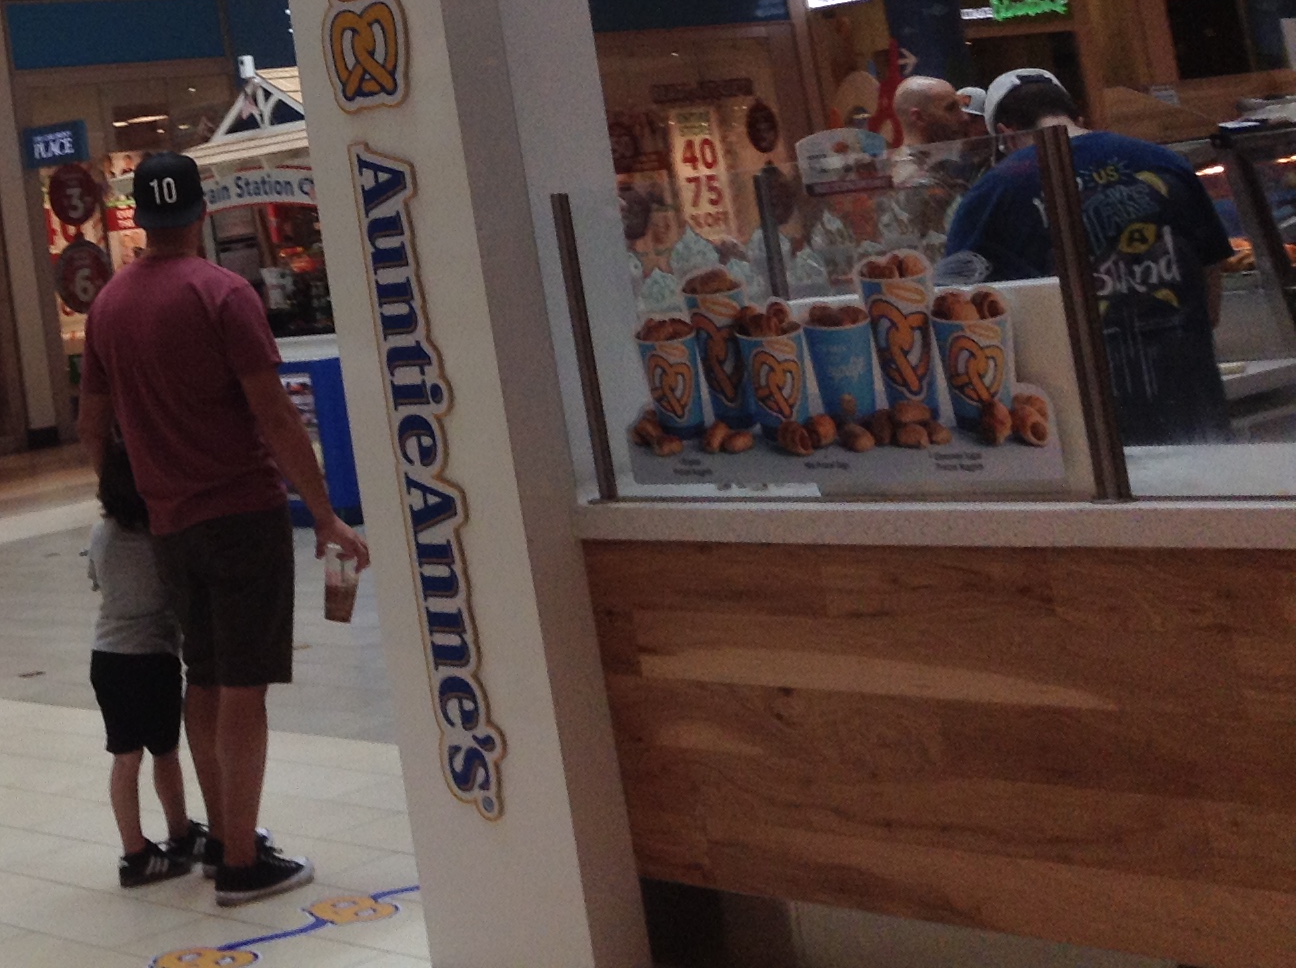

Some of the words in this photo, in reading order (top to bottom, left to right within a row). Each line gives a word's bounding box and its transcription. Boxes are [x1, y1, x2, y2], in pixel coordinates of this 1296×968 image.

[33, 138, 75, 160] PLACE
[682, 138, 717, 170] 40
[148, 177, 177, 205] 10
[234, 173, 295, 199] Station
[686, 174, 723, 207] 75
